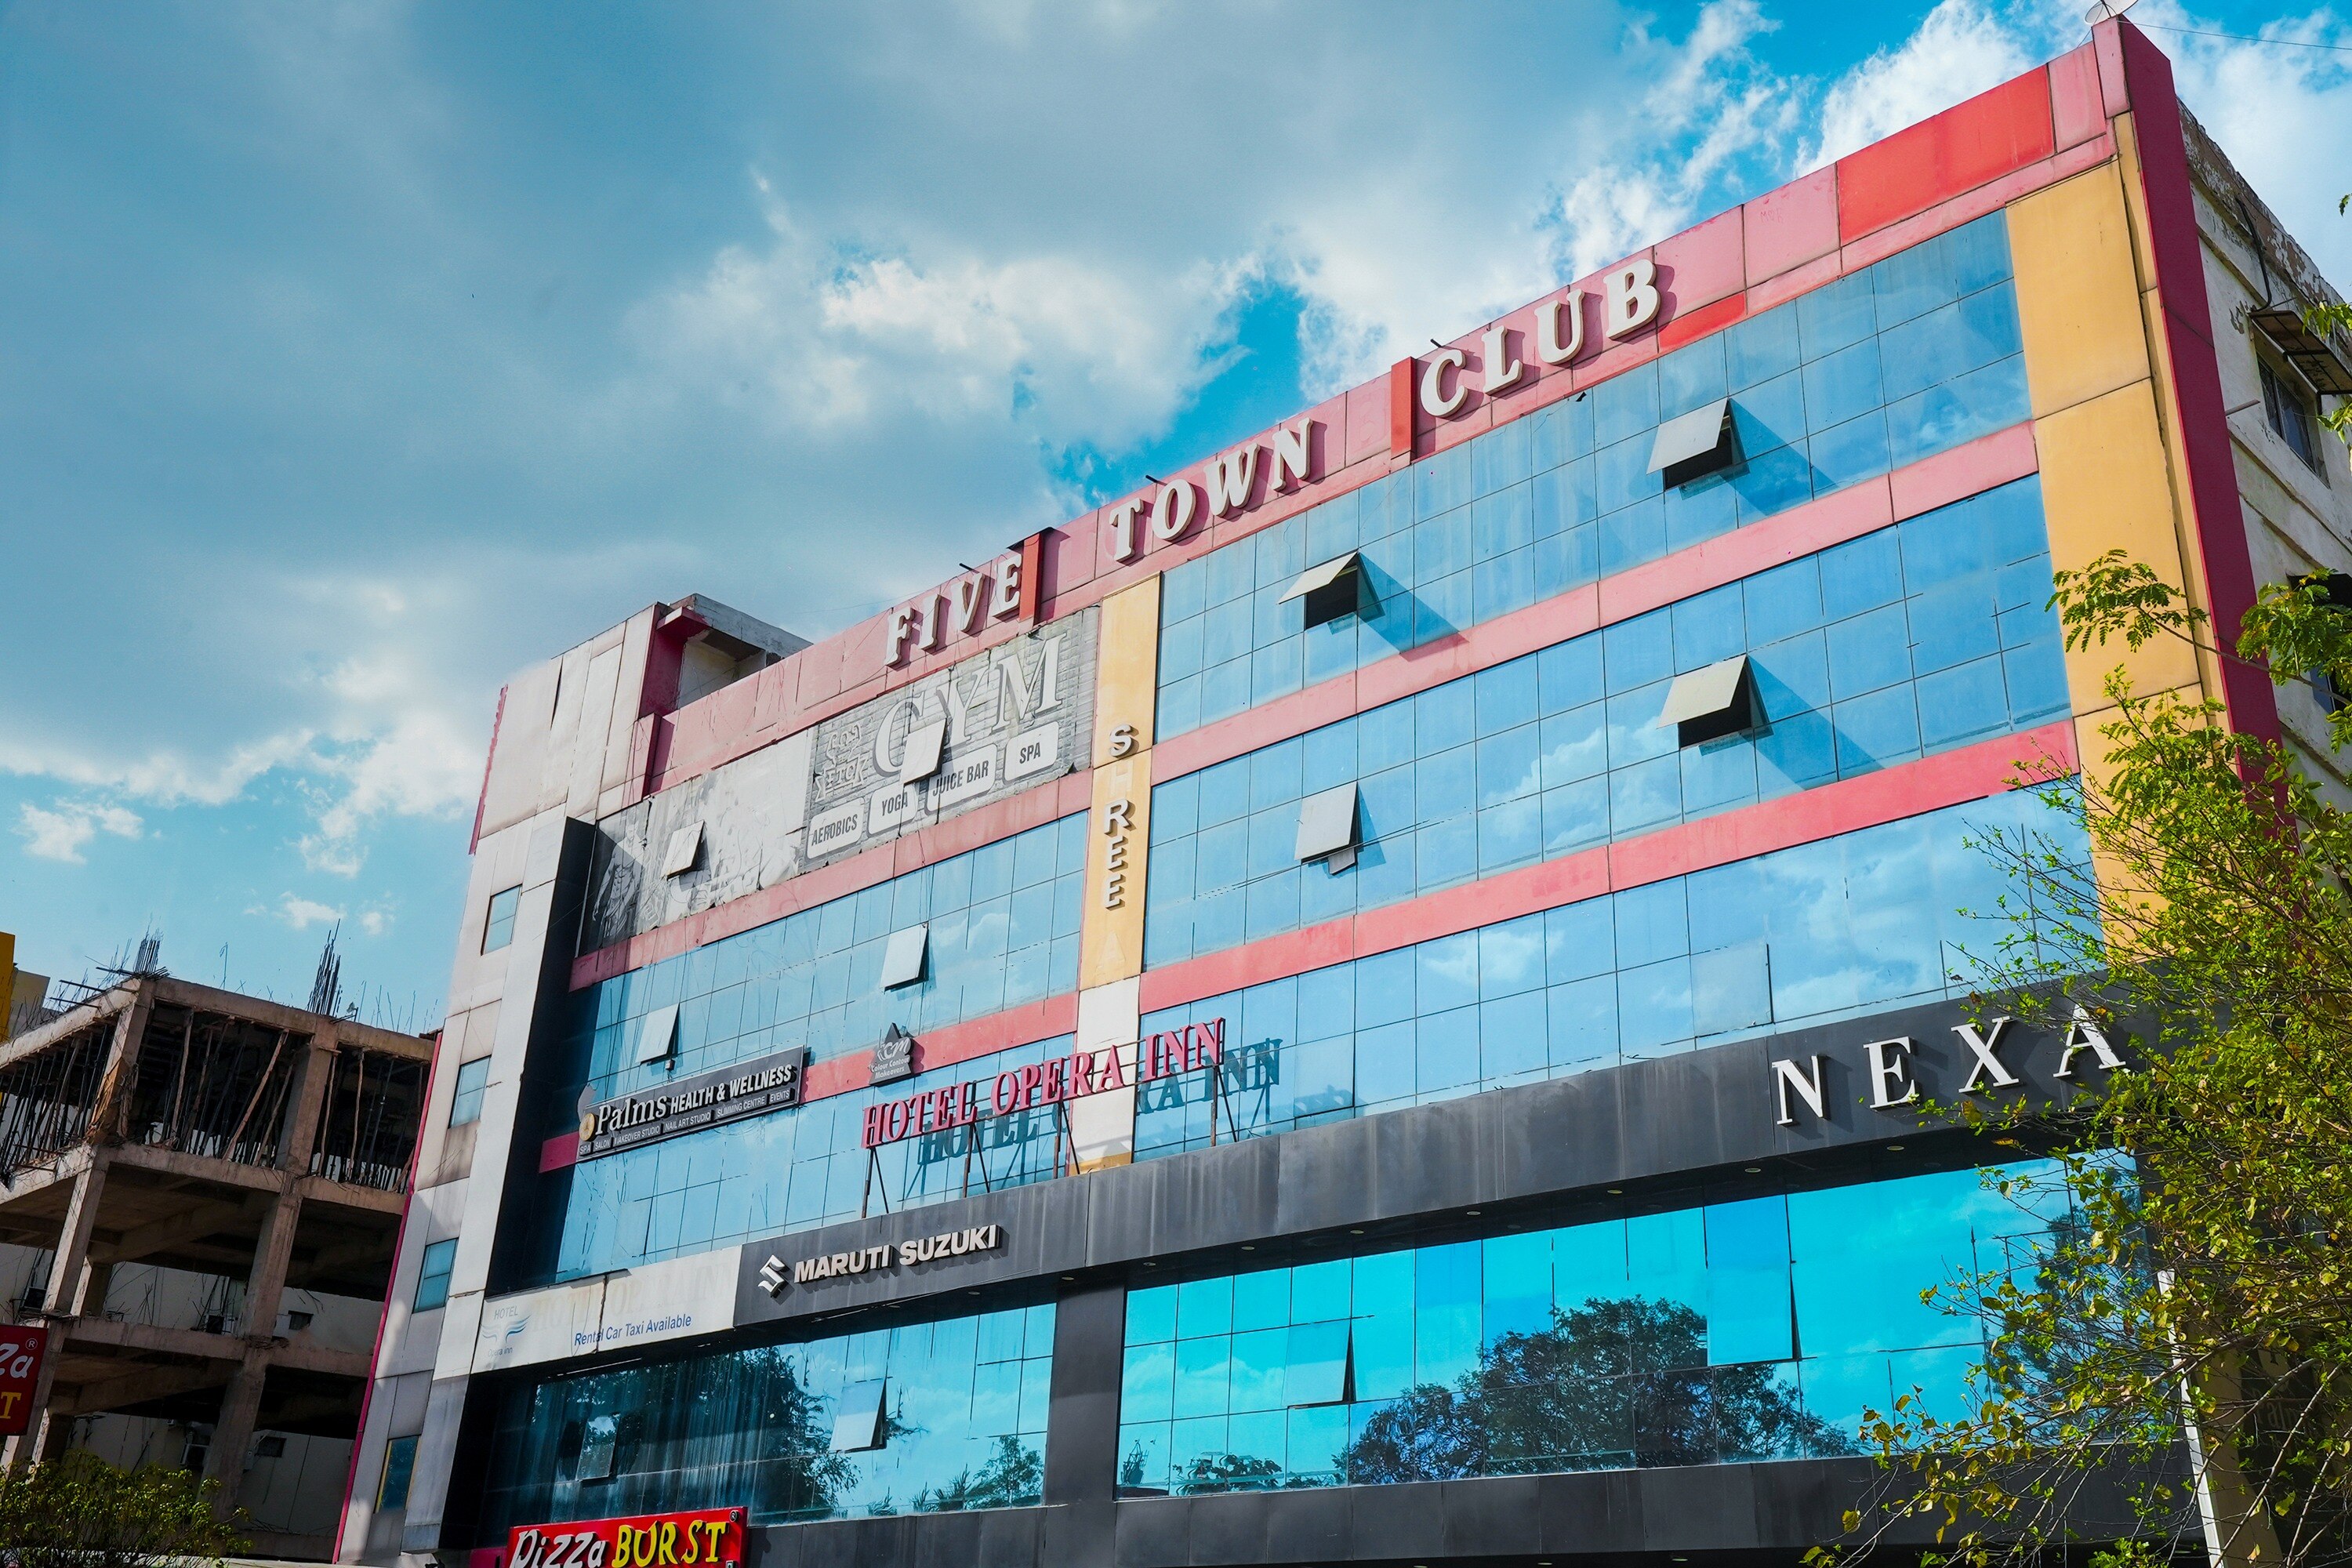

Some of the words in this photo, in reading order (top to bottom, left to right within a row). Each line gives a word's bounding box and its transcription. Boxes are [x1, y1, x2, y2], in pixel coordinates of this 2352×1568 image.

[884, 553, 1022, 667] FIVE
[1109, 417, 1314, 561] TOWN
[1420, 259, 1661, 418] CLUB
[1020, 742, 1040, 764] SPA
[882, 789, 908, 816] YOGA
[933, 770, 963, 797] JUICE
[967, 760, 989, 783] BAR
[862, 1081, 978, 1149] HOTEL
[990, 1045, 1124, 1115] OPERA
[1142, 1018, 1225, 1083] INN
[875, 1066, 904, 1079] Makeovers
[1771, 1004, 2126, 1125] NEXA
[579, 1145, 591, 1156] SPA
[594, 1140, 610, 1150] SALON
[641, 1126, 660, 1137] STUDIO
[665, 1121, 678, 1131] NAIL
[678, 1117, 689, 1128] ART
[690, 1112, 711, 1125] STUDIO
[717, 1104, 742, 1117] SLIMMING
[743, 1096, 765, 1112] CENTRE
[770, 1090, 790, 1102] EVENTS
[595, 1095, 667, 1136] Palms
[670, 1086, 714, 1115] HEALTH
[717, 1083, 725, 1101] &
[729, 1064, 792, 1098] WELLNESS
[793, 1244, 892, 1284] MARUTI
[898, 1225, 997, 1266] SUZUKI
[494, 1305, 518, 1320] HOTEL
[575, 1330, 603, 1346] Rental
[605, 1327, 622, 1340] Car
[626, 1321, 644, 1338] Taxi
[646, 1314, 691, 1333] Available
[510, 1529, 606, 1568] Pizza
[612, 1520, 730, 1568] BURST
